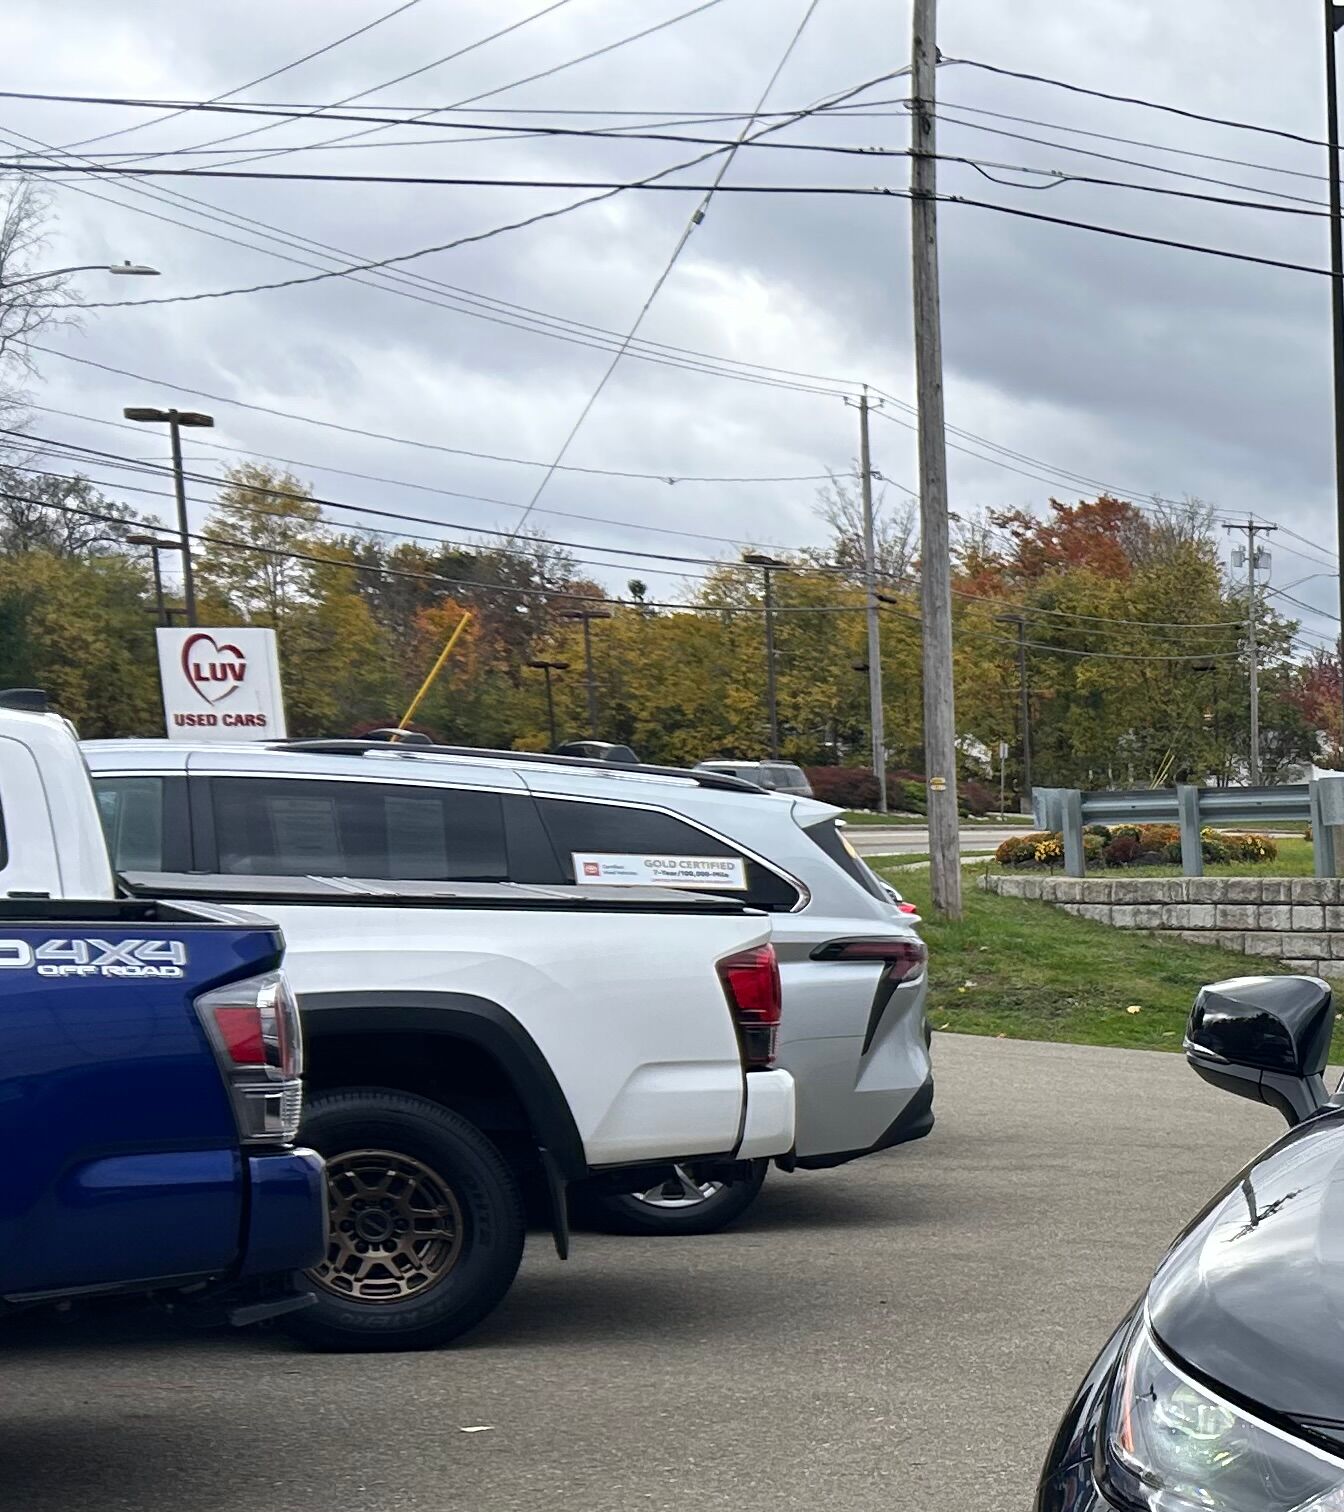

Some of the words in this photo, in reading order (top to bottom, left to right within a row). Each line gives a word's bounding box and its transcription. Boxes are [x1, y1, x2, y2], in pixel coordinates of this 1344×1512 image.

[193, 662, 247, 682] LUV
[173, 713, 218, 727] USED
[221, 713, 267, 727] CARS
[643, 859, 677, 869] GOLD
[678, 860, 735, 871] CERTIFIED
[35, 938, 188, 967] 4X4
[37, 964, 99, 977] OFF
[101, 965, 184, 979] ROAD
